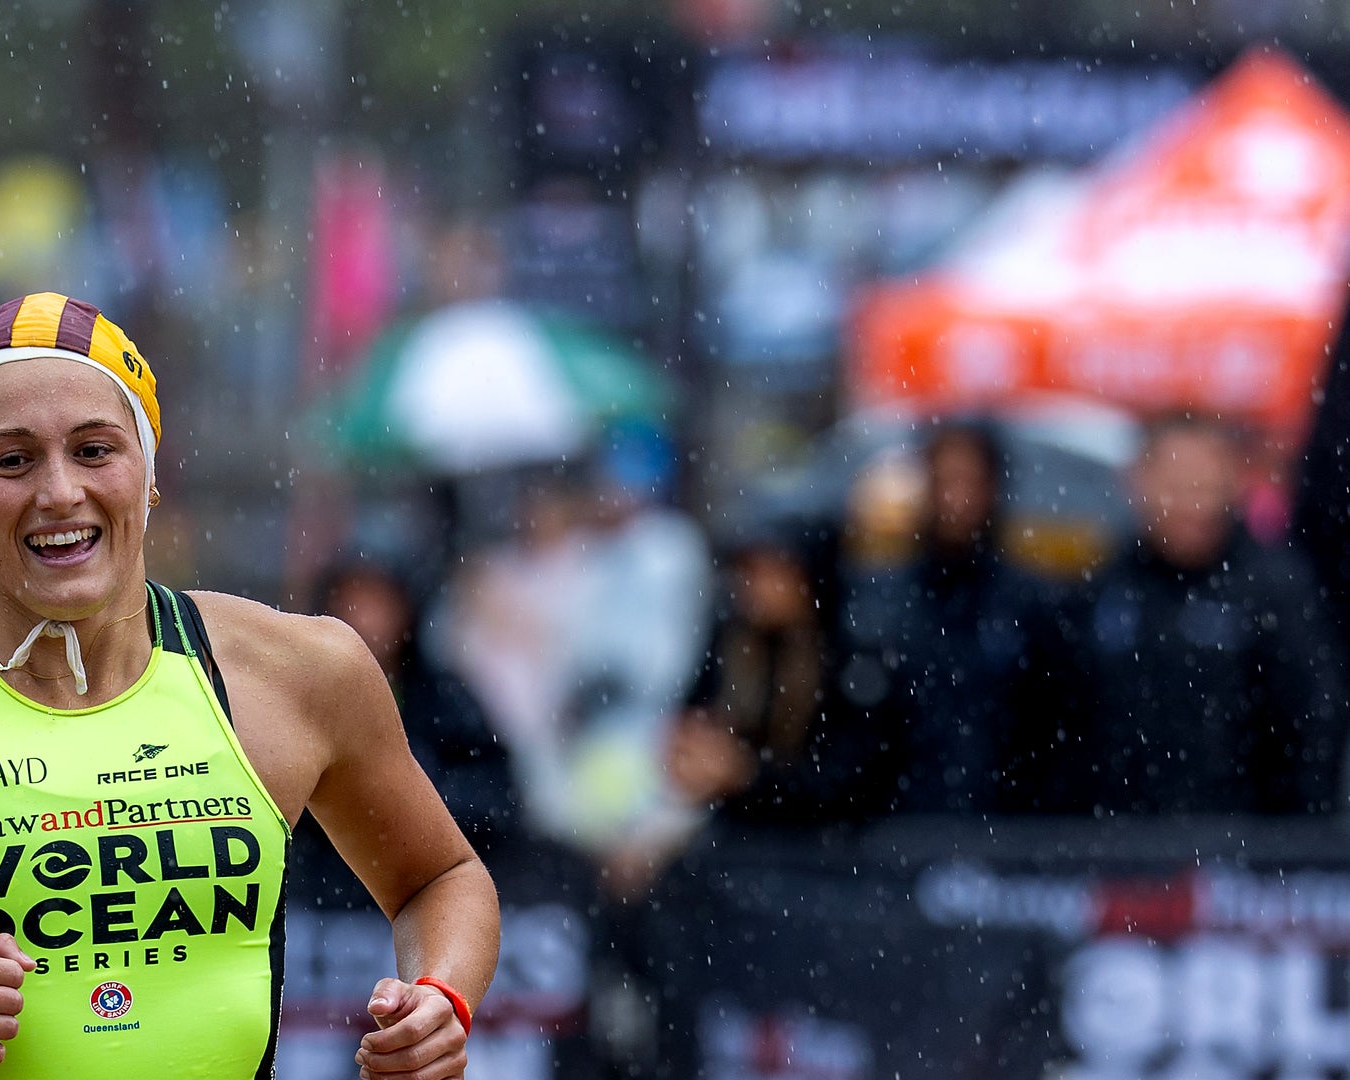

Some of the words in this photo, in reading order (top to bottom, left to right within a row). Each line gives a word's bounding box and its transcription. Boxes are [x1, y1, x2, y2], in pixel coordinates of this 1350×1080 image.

[97, 770, 157, 785] RACE
[165, 761, 209, 778] ONE
[35, 945, 188, 975] SERIES
[83, 1020, 140, 1034] Queensland
